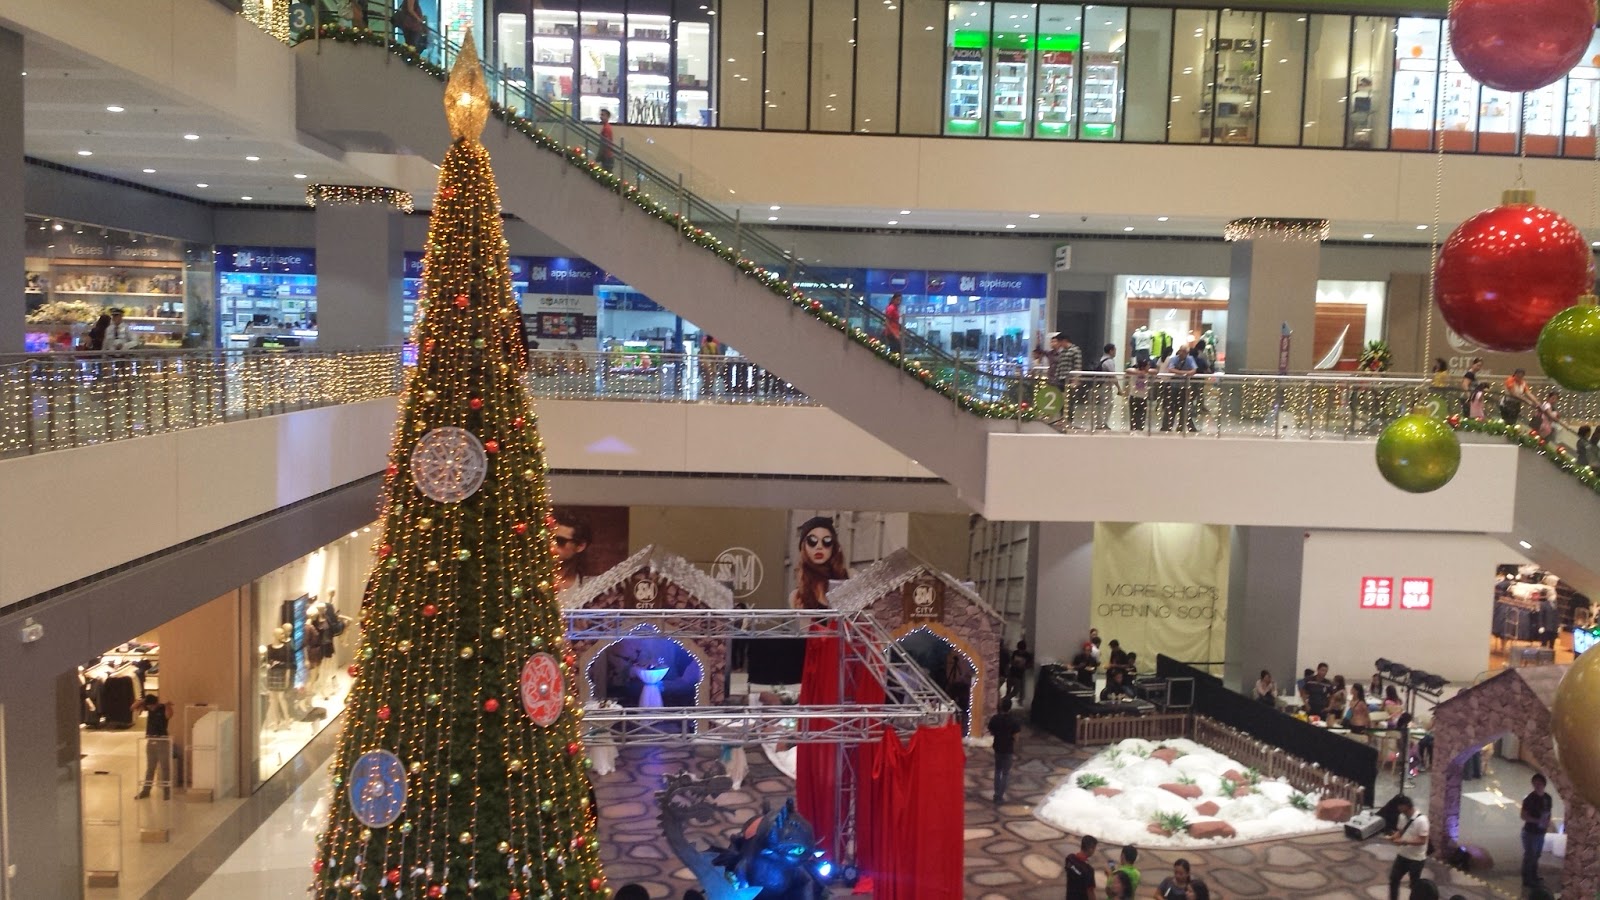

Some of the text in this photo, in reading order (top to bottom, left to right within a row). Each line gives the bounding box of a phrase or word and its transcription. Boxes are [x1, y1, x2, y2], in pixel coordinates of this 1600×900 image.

[293, 9, 305, 28] 3
[69, 244, 104, 255] Vases
[256, 254, 301, 267] appliance
[980, 278, 1022, 291] appliance
[1126, 279, 1207, 295] NAUTICA
[1044, 391, 1056, 410] 2
[1426, 401, 1440, 418] 2
[1106, 583, 1219, 600] MORE SHOPS
[915, 606, 934, 614] CITY
[1097, 603, 1227, 622] OPENING SOON
